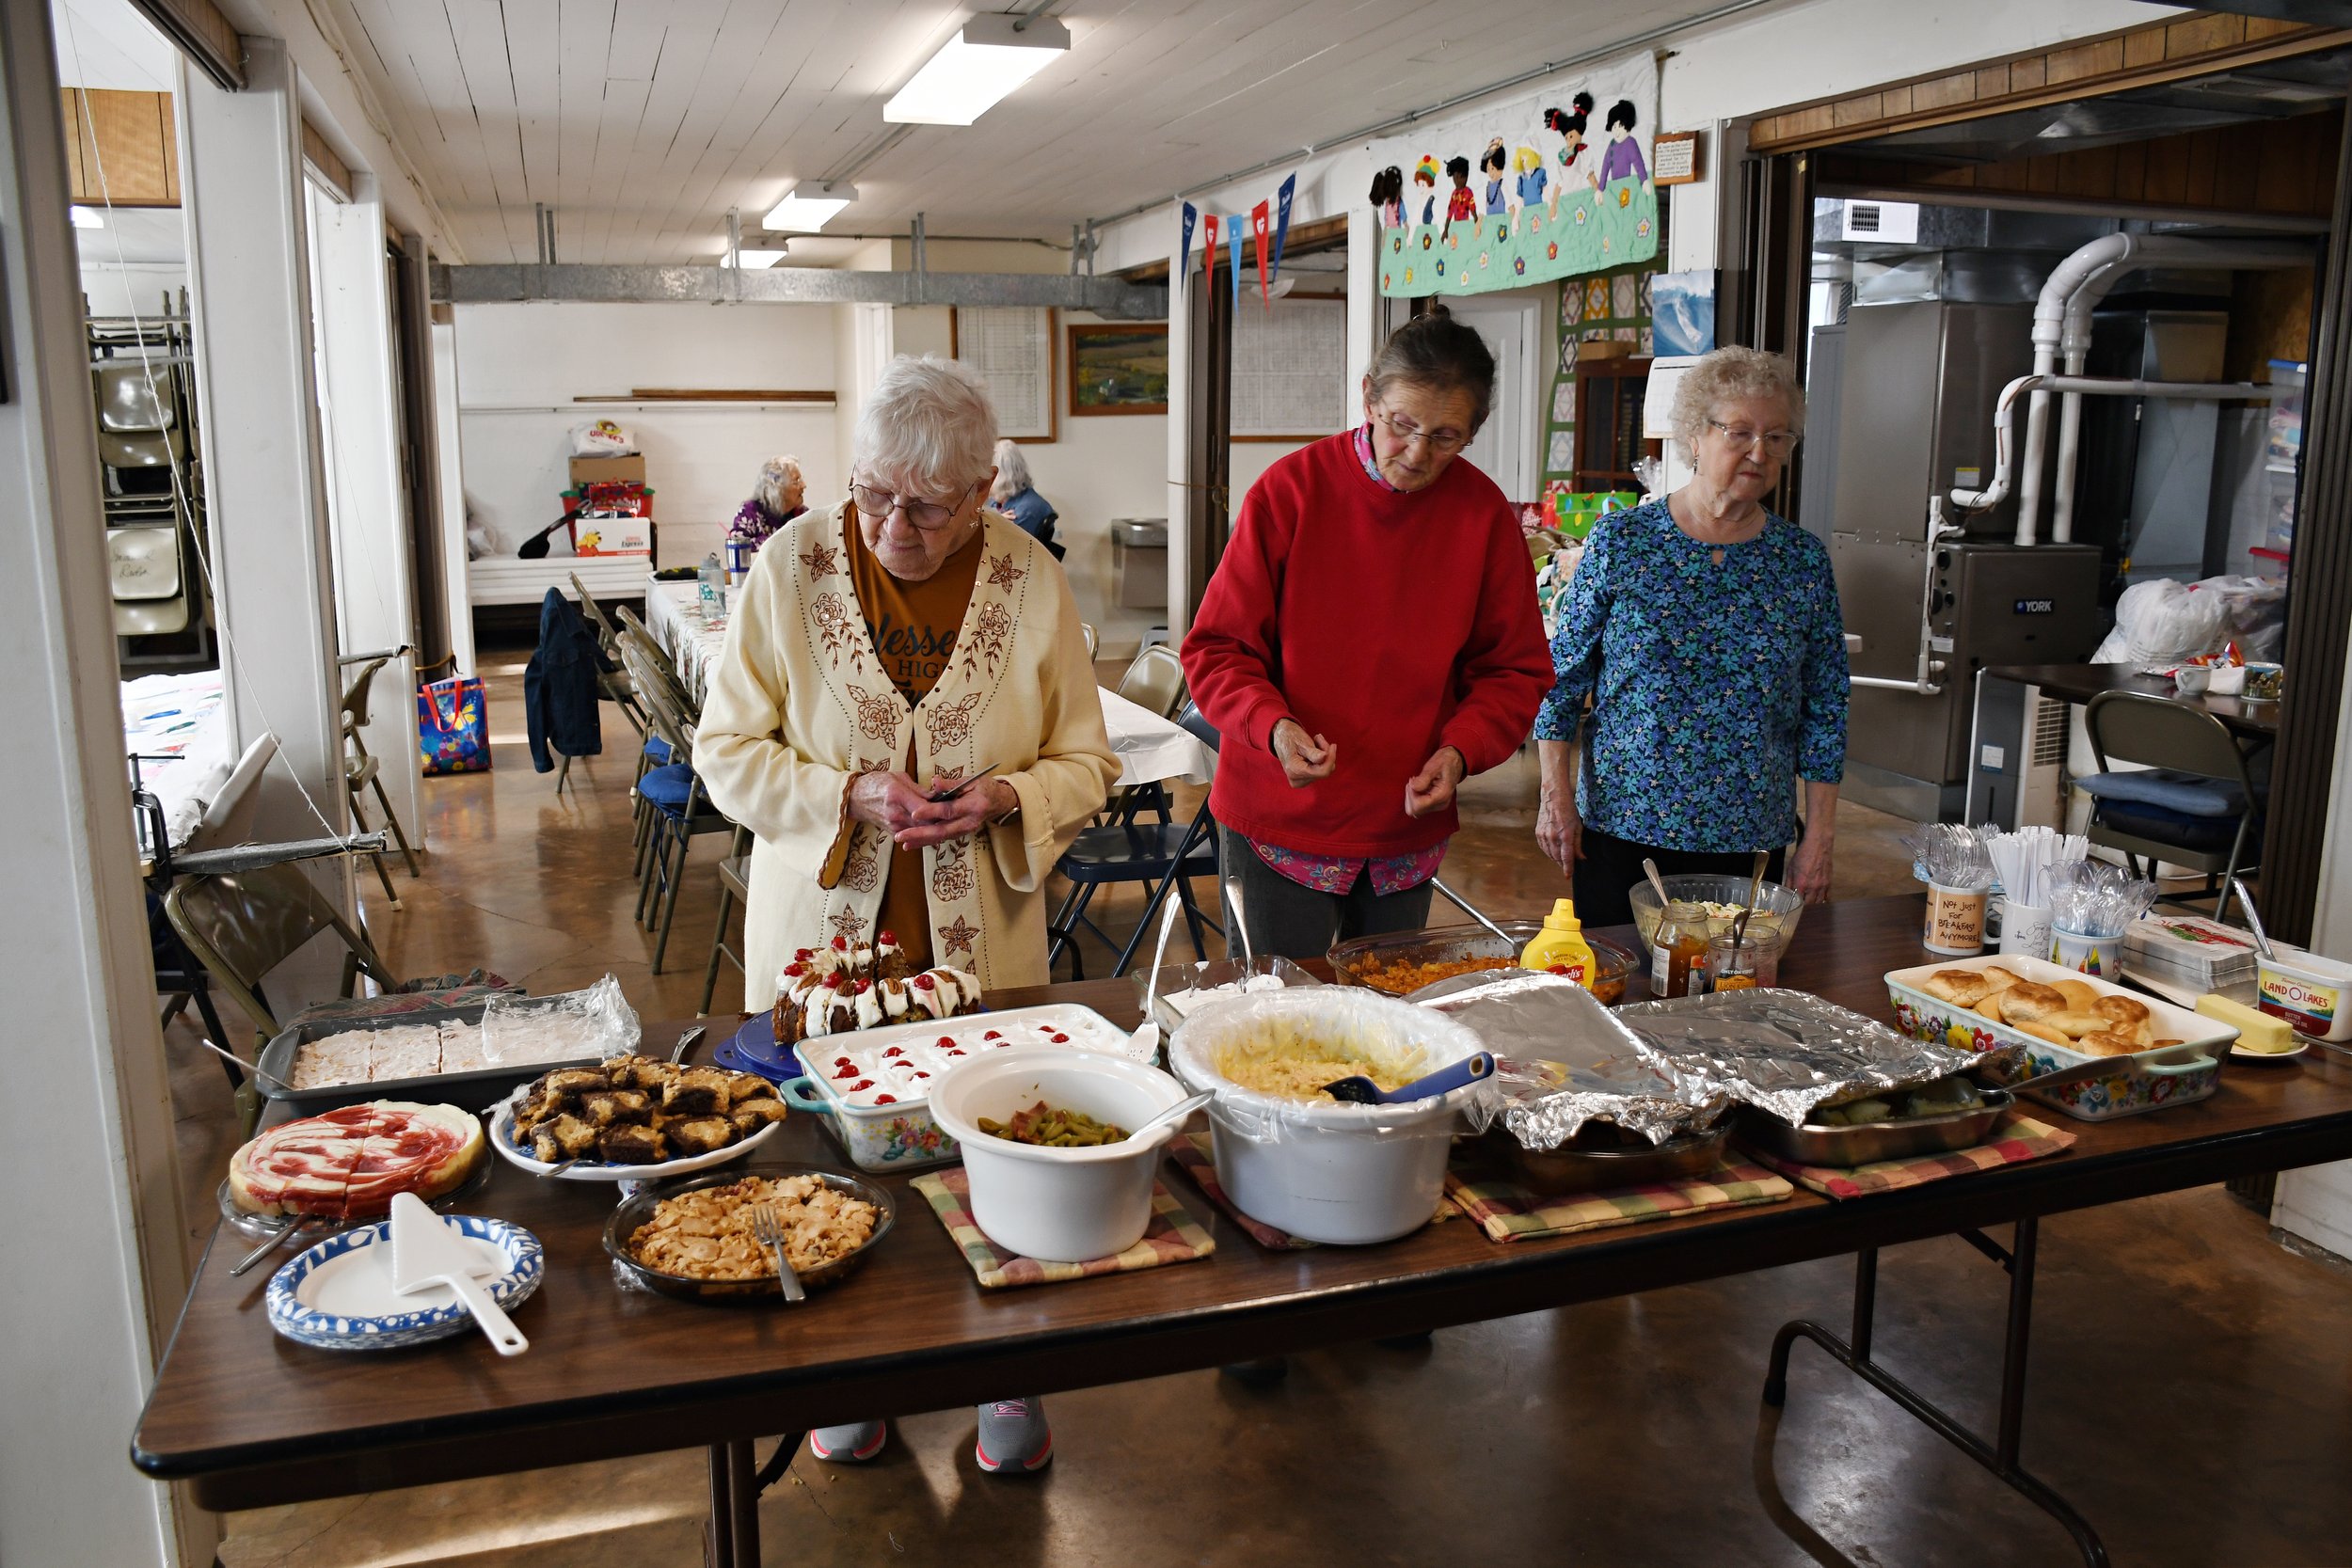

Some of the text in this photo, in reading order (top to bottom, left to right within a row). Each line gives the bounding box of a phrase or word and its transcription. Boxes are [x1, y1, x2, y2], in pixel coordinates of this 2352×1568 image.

[2026, 601, 2052, 611] YORK
[866, 613, 957, 657] lesse
[898, 659, 946, 678] HIG
[1943, 899, 1957, 909] Not
[2264, 981, 2287, 995] LAND
[2289, 987, 2302, 1001] O
[2303, 992, 2328, 1007] LAKES
[2284, 1011, 2301, 1021] BUTTER
